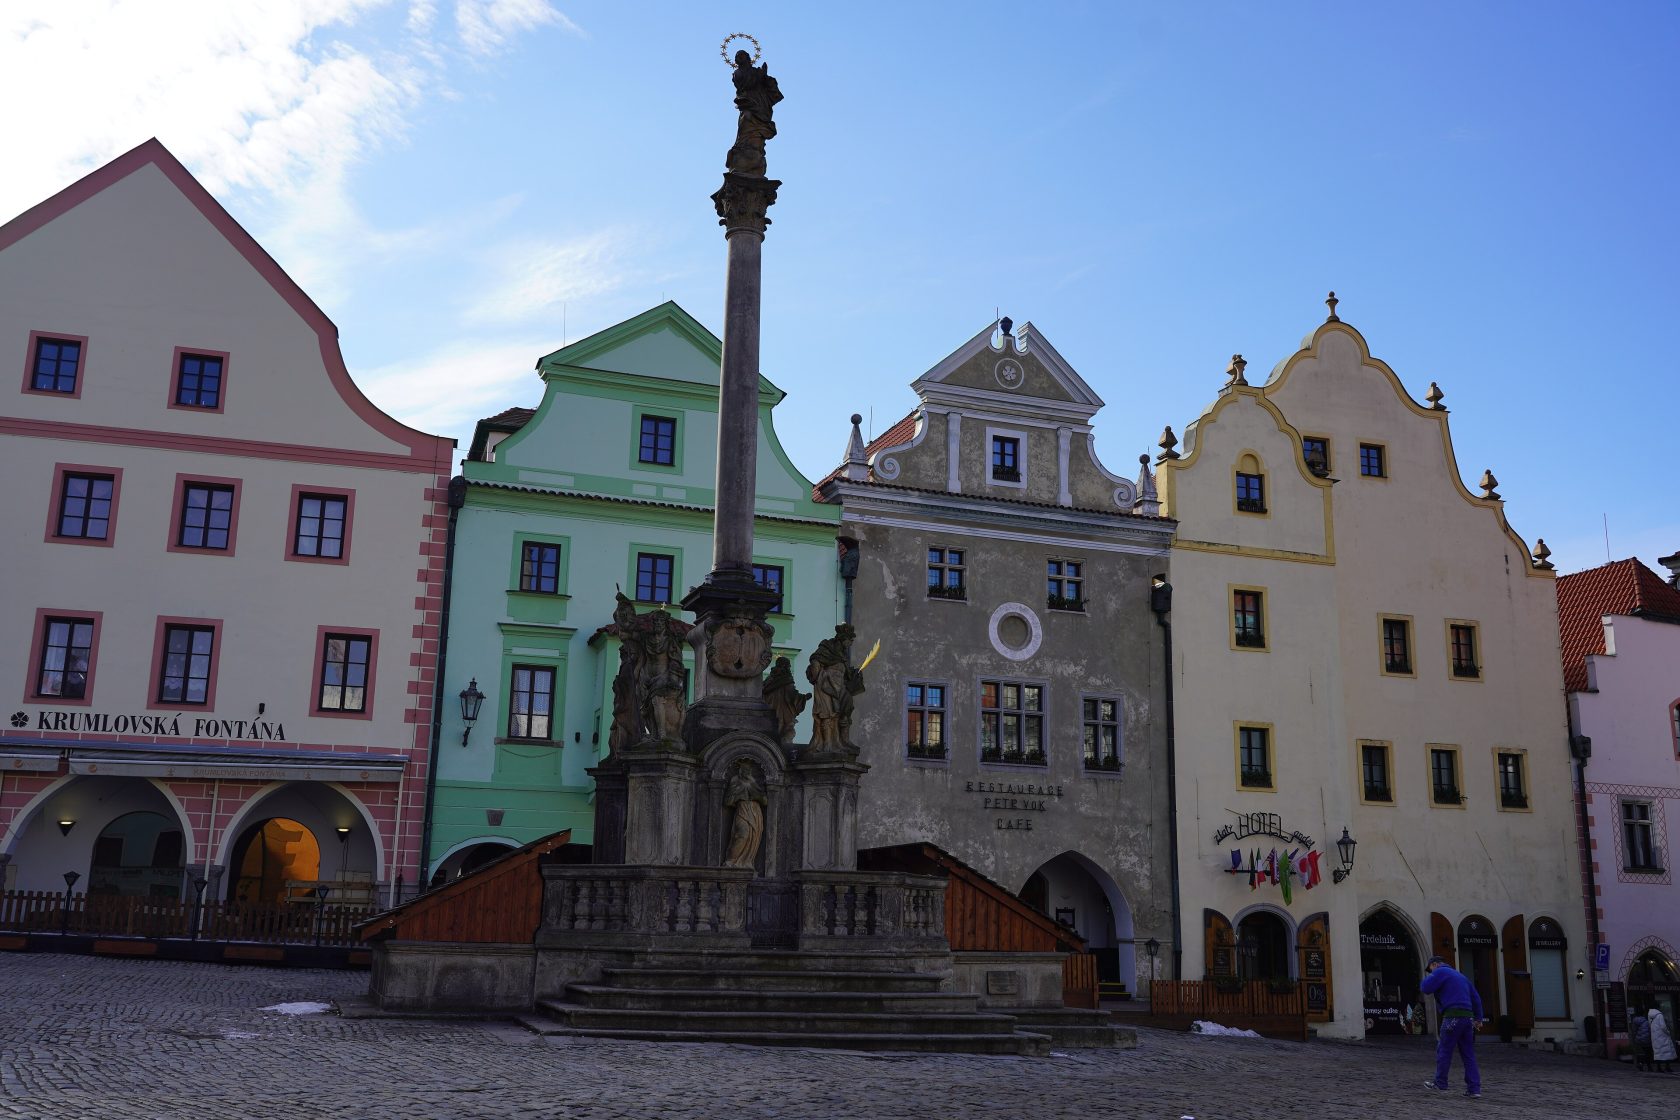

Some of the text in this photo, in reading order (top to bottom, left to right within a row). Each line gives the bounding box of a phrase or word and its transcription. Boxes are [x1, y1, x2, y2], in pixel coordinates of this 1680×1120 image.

[38, 711, 286, 741] KRUMLOVSKÁ FONTÁNA
[965, 781, 1064, 798] RESTAURACE
[984, 799, 1046, 812] PETR VOK
[1238, 812, 1282, 840] HOTEL
[1599, 947, 1608, 961] P
